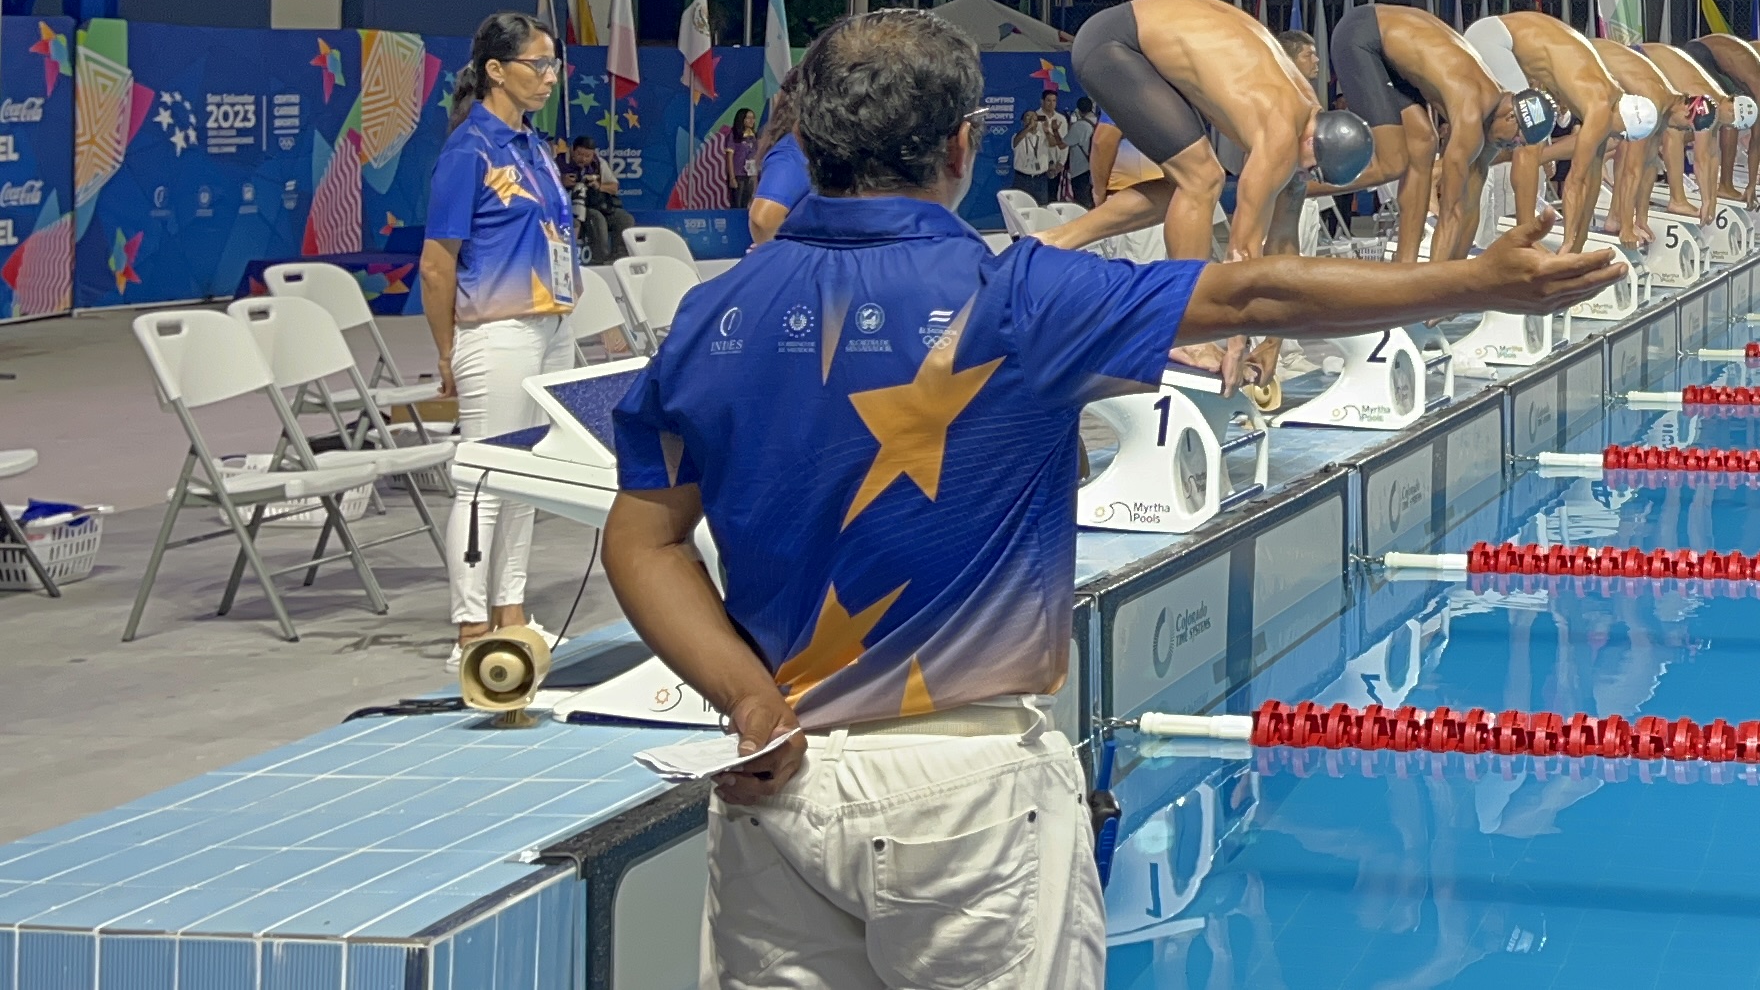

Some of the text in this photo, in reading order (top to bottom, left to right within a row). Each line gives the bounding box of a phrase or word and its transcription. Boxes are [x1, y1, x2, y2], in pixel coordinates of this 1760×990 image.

[206, 104, 256, 129] 2023
[1518, 99, 1533, 129] TAYLOR
[0, 135, 20, 161] EL
[612, 157, 643, 179] 23
[1716, 208, 1728, 230] 6
[0, 219, 18, 245] EL
[1665, 225, 1679, 249] 5
[710, 339, 744, 352] INDES
[1366, 330, 1391, 363] 2
[1153, 395, 1172, 447] 1
[1361, 405, 1391, 415] Myrtha
[1133, 502, 1171, 514] Myrtha
[1133, 513, 1161, 524] Pools
[1175, 600, 1208, 633] Colorado
